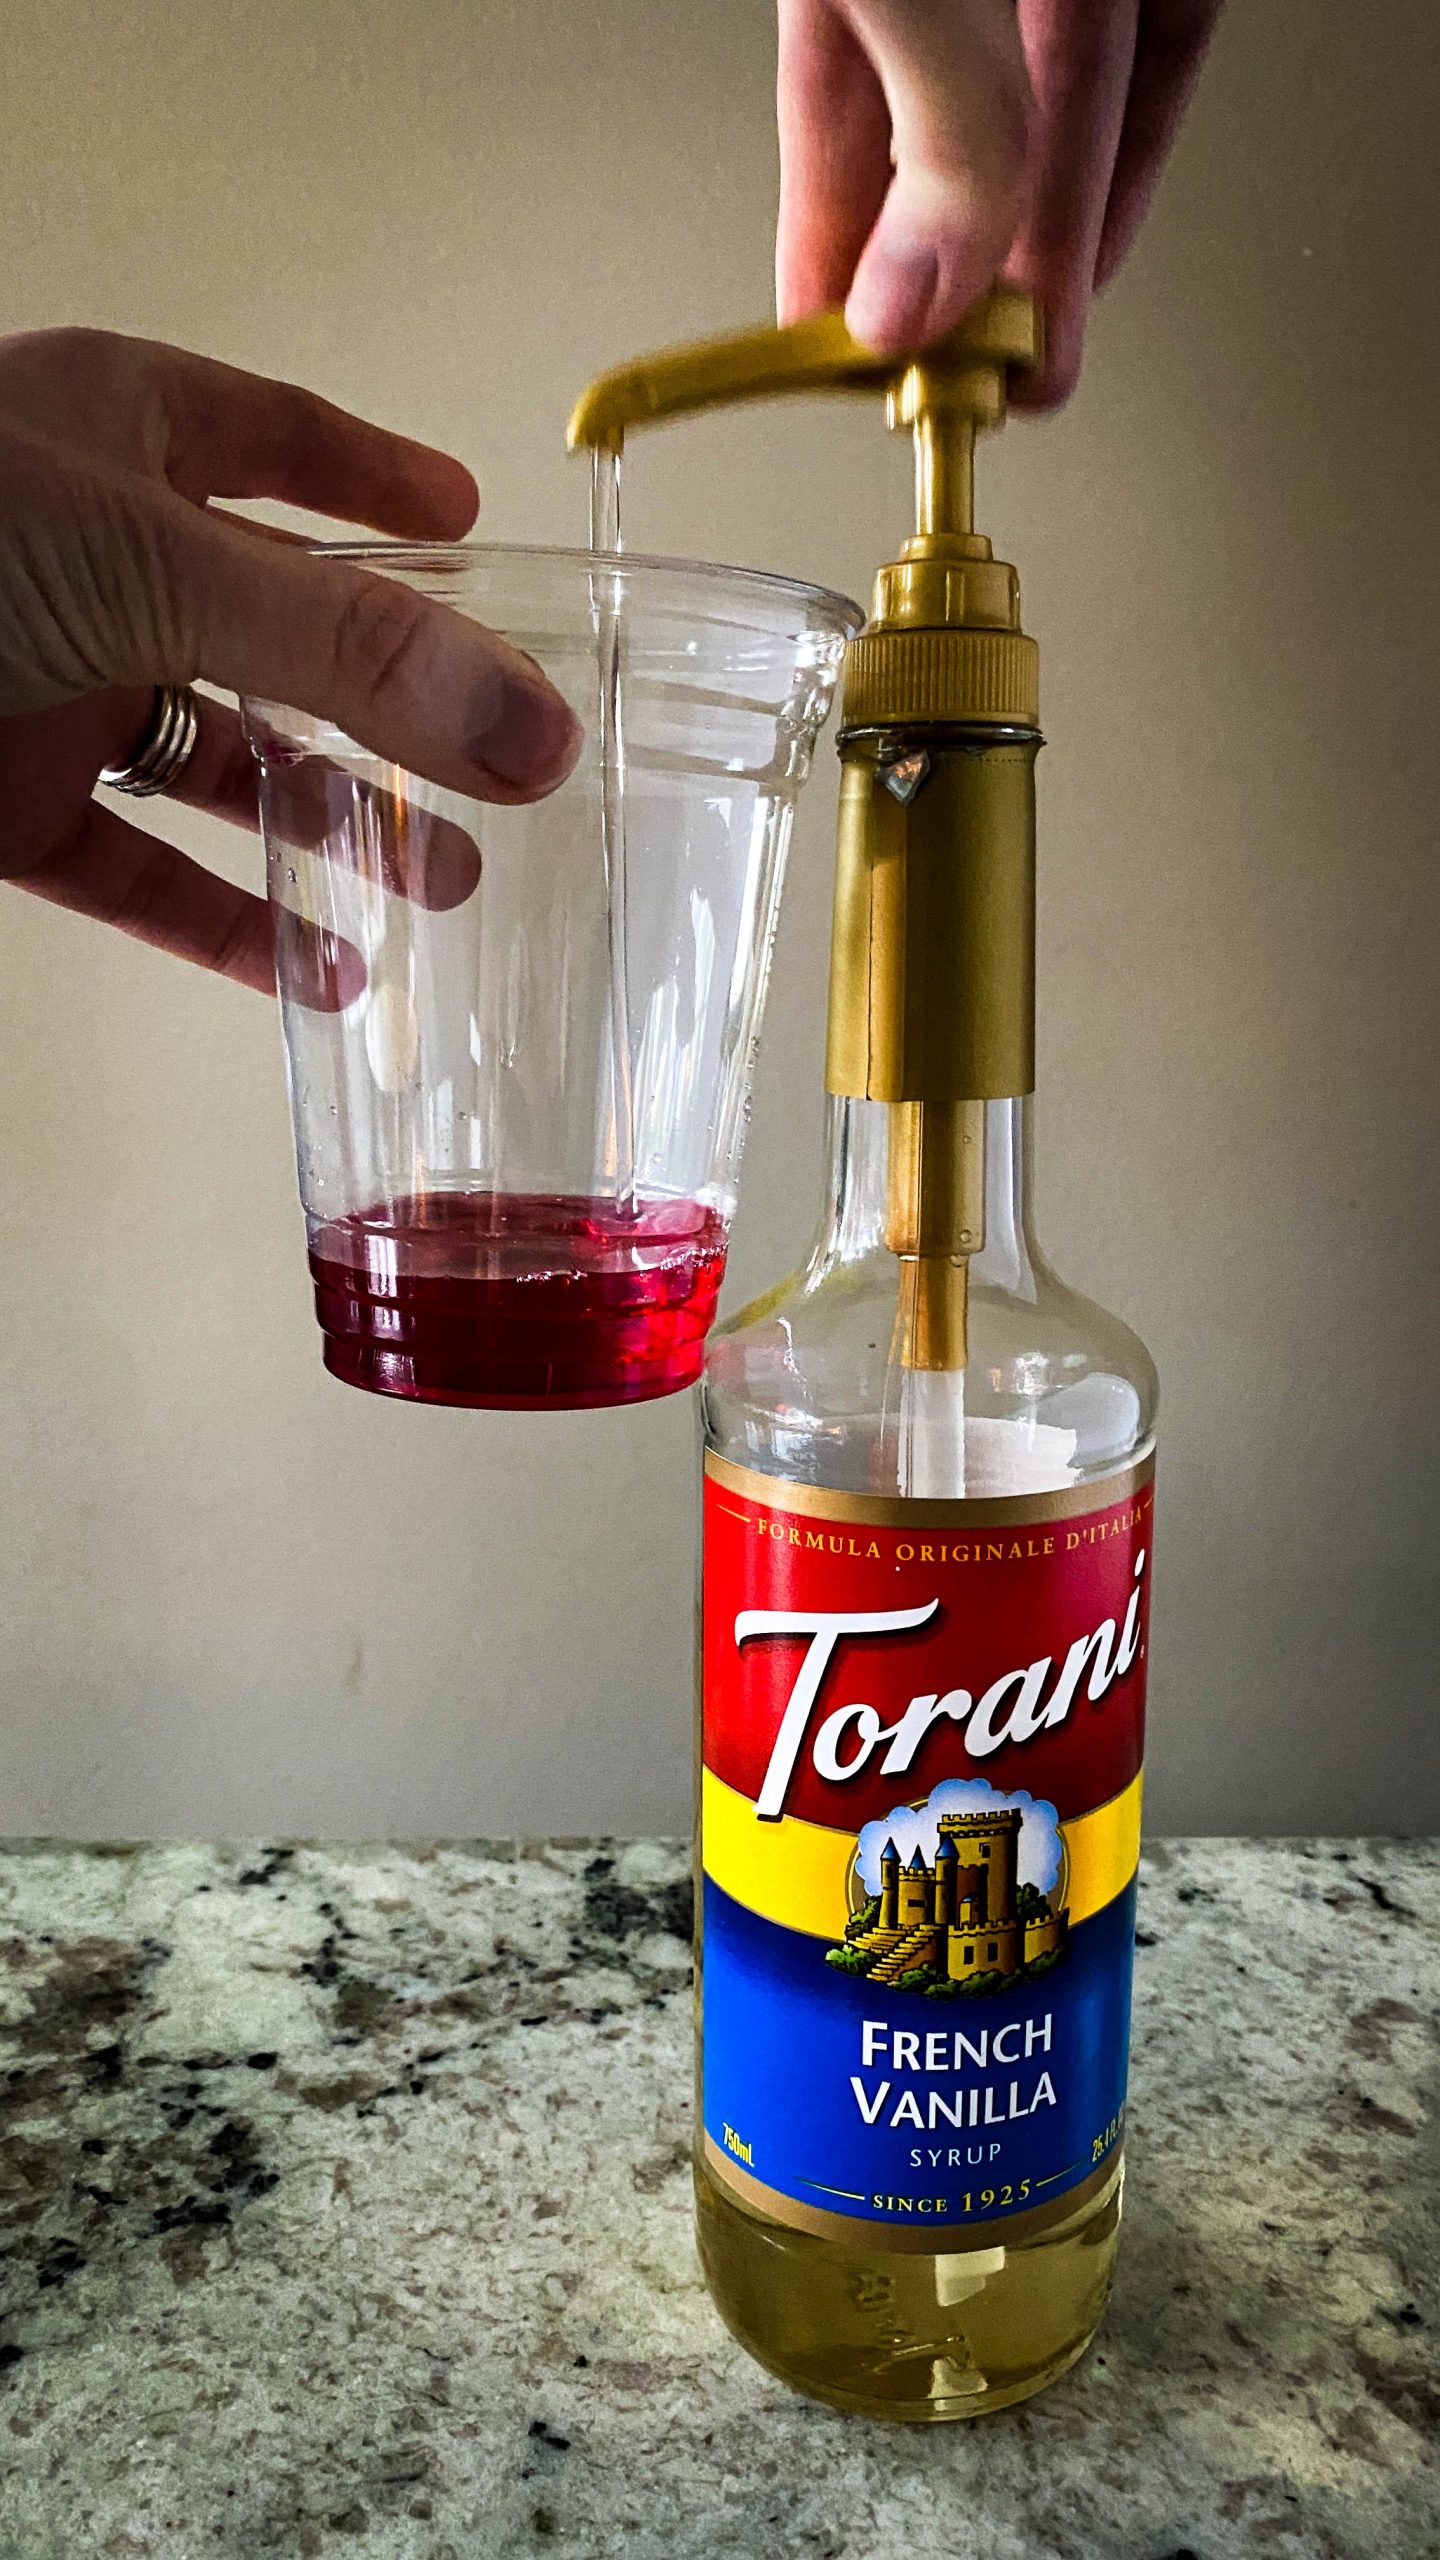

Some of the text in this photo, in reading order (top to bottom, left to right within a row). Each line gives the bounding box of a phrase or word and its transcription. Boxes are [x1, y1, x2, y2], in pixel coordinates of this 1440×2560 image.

[757, 1506, 1142, 1562] FORMULA ORIGINALE D'ITALIA
[734, 1548, 1146, 1816] Torani
[862, 2013, 1053, 2071] FRENCH
[850, 2072, 1057, 2129] VANILLA
[909, 2143, 1001, 2168] SYRUP
[873, 2178, 1032, 2213] SINCE 1925
